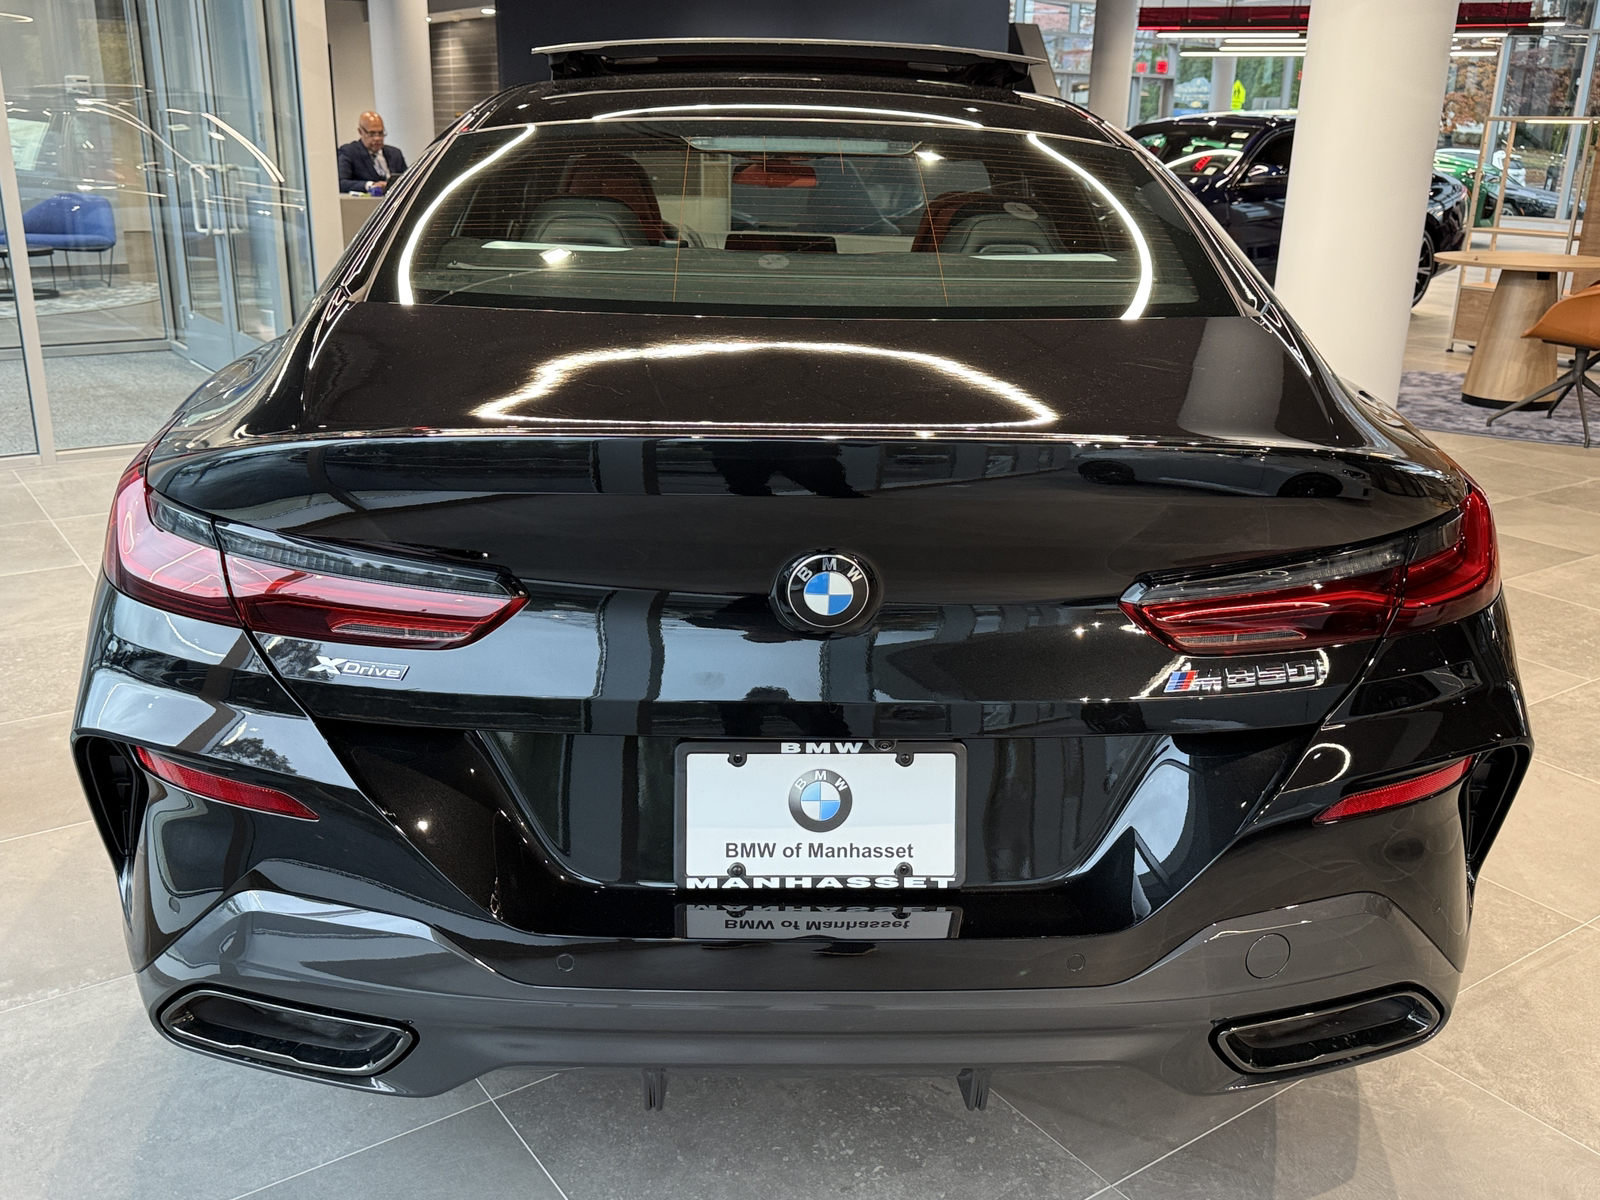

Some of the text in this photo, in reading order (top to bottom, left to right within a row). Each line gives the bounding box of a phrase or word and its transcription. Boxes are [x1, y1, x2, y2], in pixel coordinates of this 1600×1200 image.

[797, 558, 863, 582] BMW
[780, 742, 863, 754] BMW
[794, 770, 848, 791] BMW
[725, 842, 914, 858] BMW of Manhasset
[686, 876, 956, 889] MANHASSET
